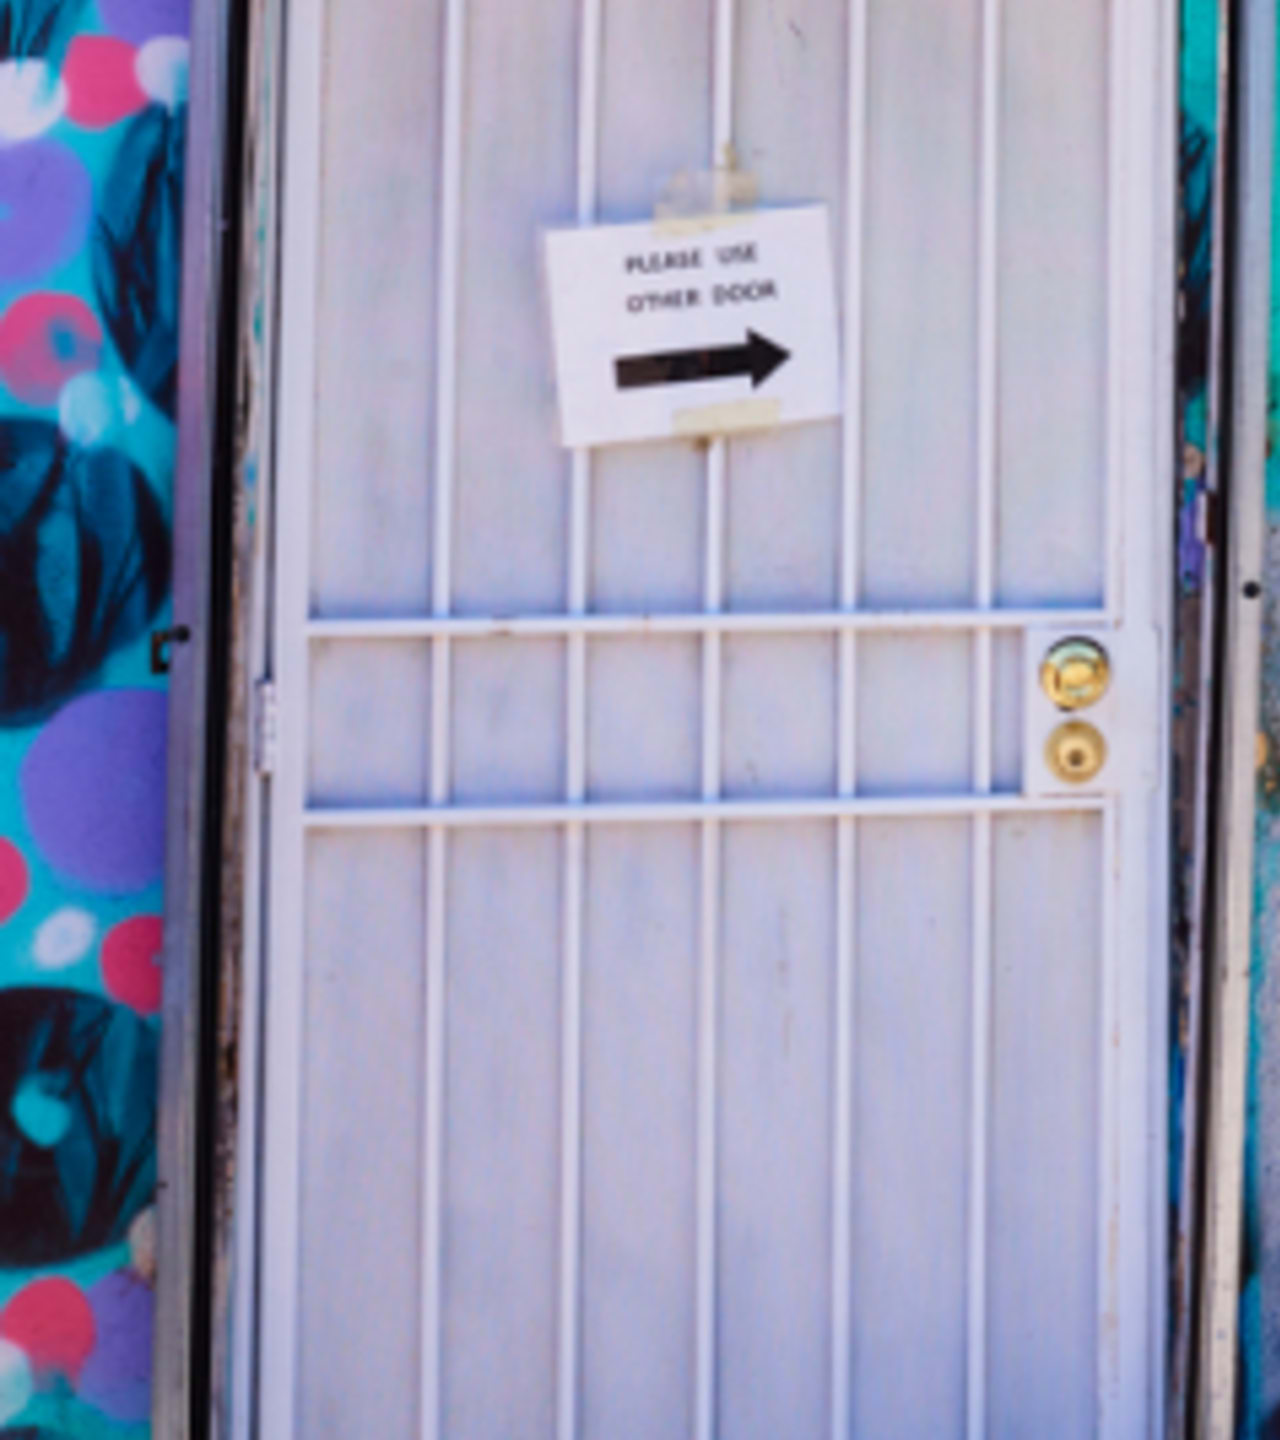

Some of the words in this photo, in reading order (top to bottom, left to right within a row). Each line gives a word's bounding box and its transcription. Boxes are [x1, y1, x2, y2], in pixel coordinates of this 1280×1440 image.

[624, 249, 700, 274] PLEASE
[714, 241, 758, 265] USE
[626, 287, 701, 314] OTHER
[712, 278, 777, 306] DOOR
